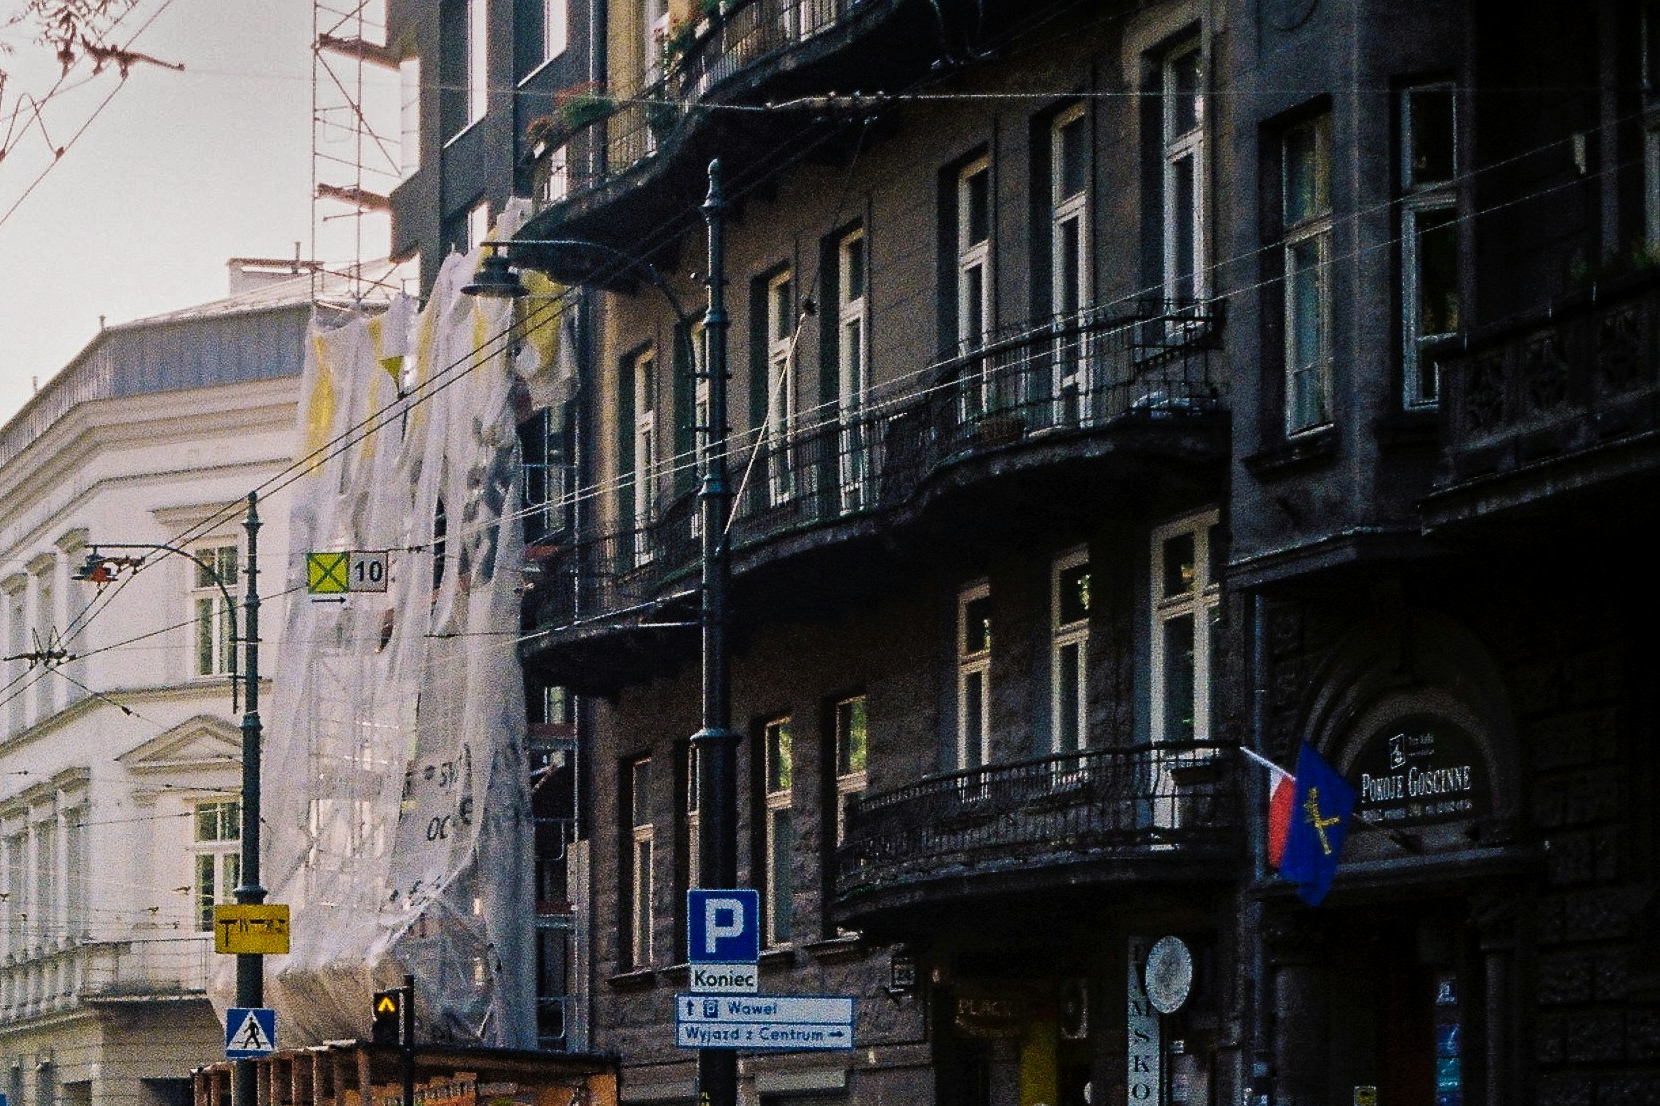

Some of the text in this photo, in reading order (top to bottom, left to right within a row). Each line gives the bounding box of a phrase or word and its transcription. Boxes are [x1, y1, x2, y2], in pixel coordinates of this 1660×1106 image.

[354, 560, 383, 583] 10
[705, 898, 744, 953] P
[694, 969, 755, 988] Koniec
[728, 1000, 778, 1016] Wawel
[685, 1026, 741, 1043] Wyjazd
[759, 1027, 824, 1042] Centrum
